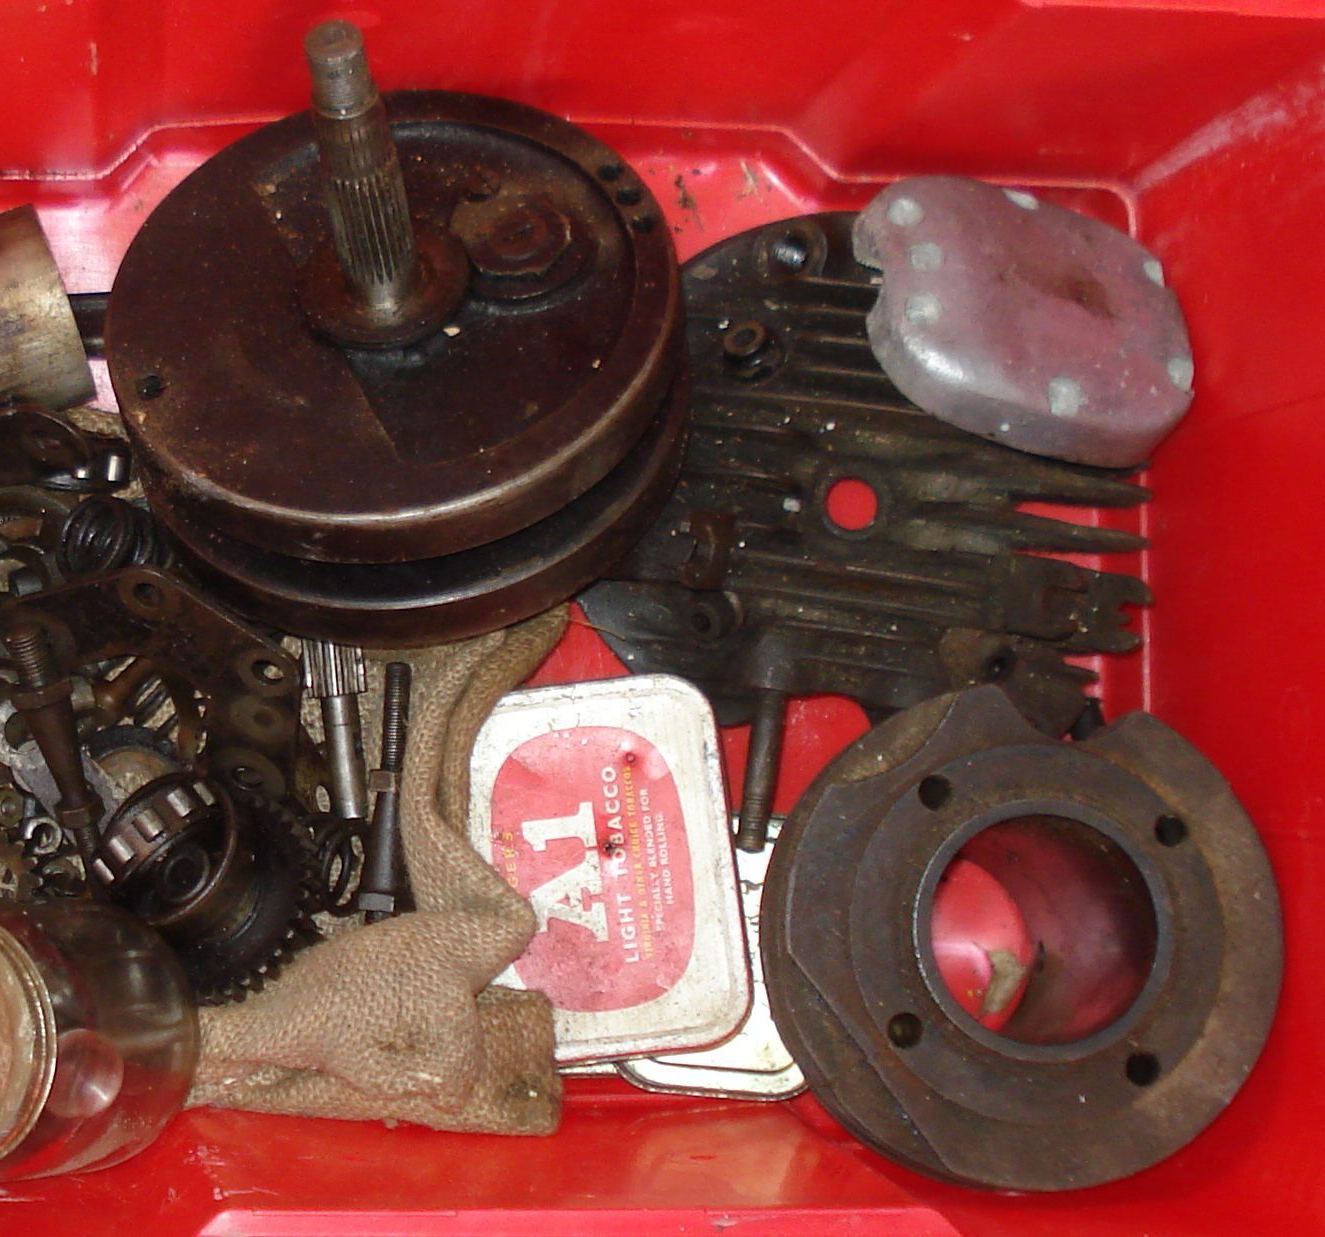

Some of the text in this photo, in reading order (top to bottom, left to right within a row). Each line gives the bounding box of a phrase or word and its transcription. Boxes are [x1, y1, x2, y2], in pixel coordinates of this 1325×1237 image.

[623, 766, 636, 817] TOBACCOS
[521, 801, 610, 942] A1
[601, 767, 639, 963] LIGHT TOBACCO
[628, 822, 642, 858] CHOICE
[639, 788, 665, 931] SPECIALLY BLENDED FOR
[661, 869, 674, 905] HAND
